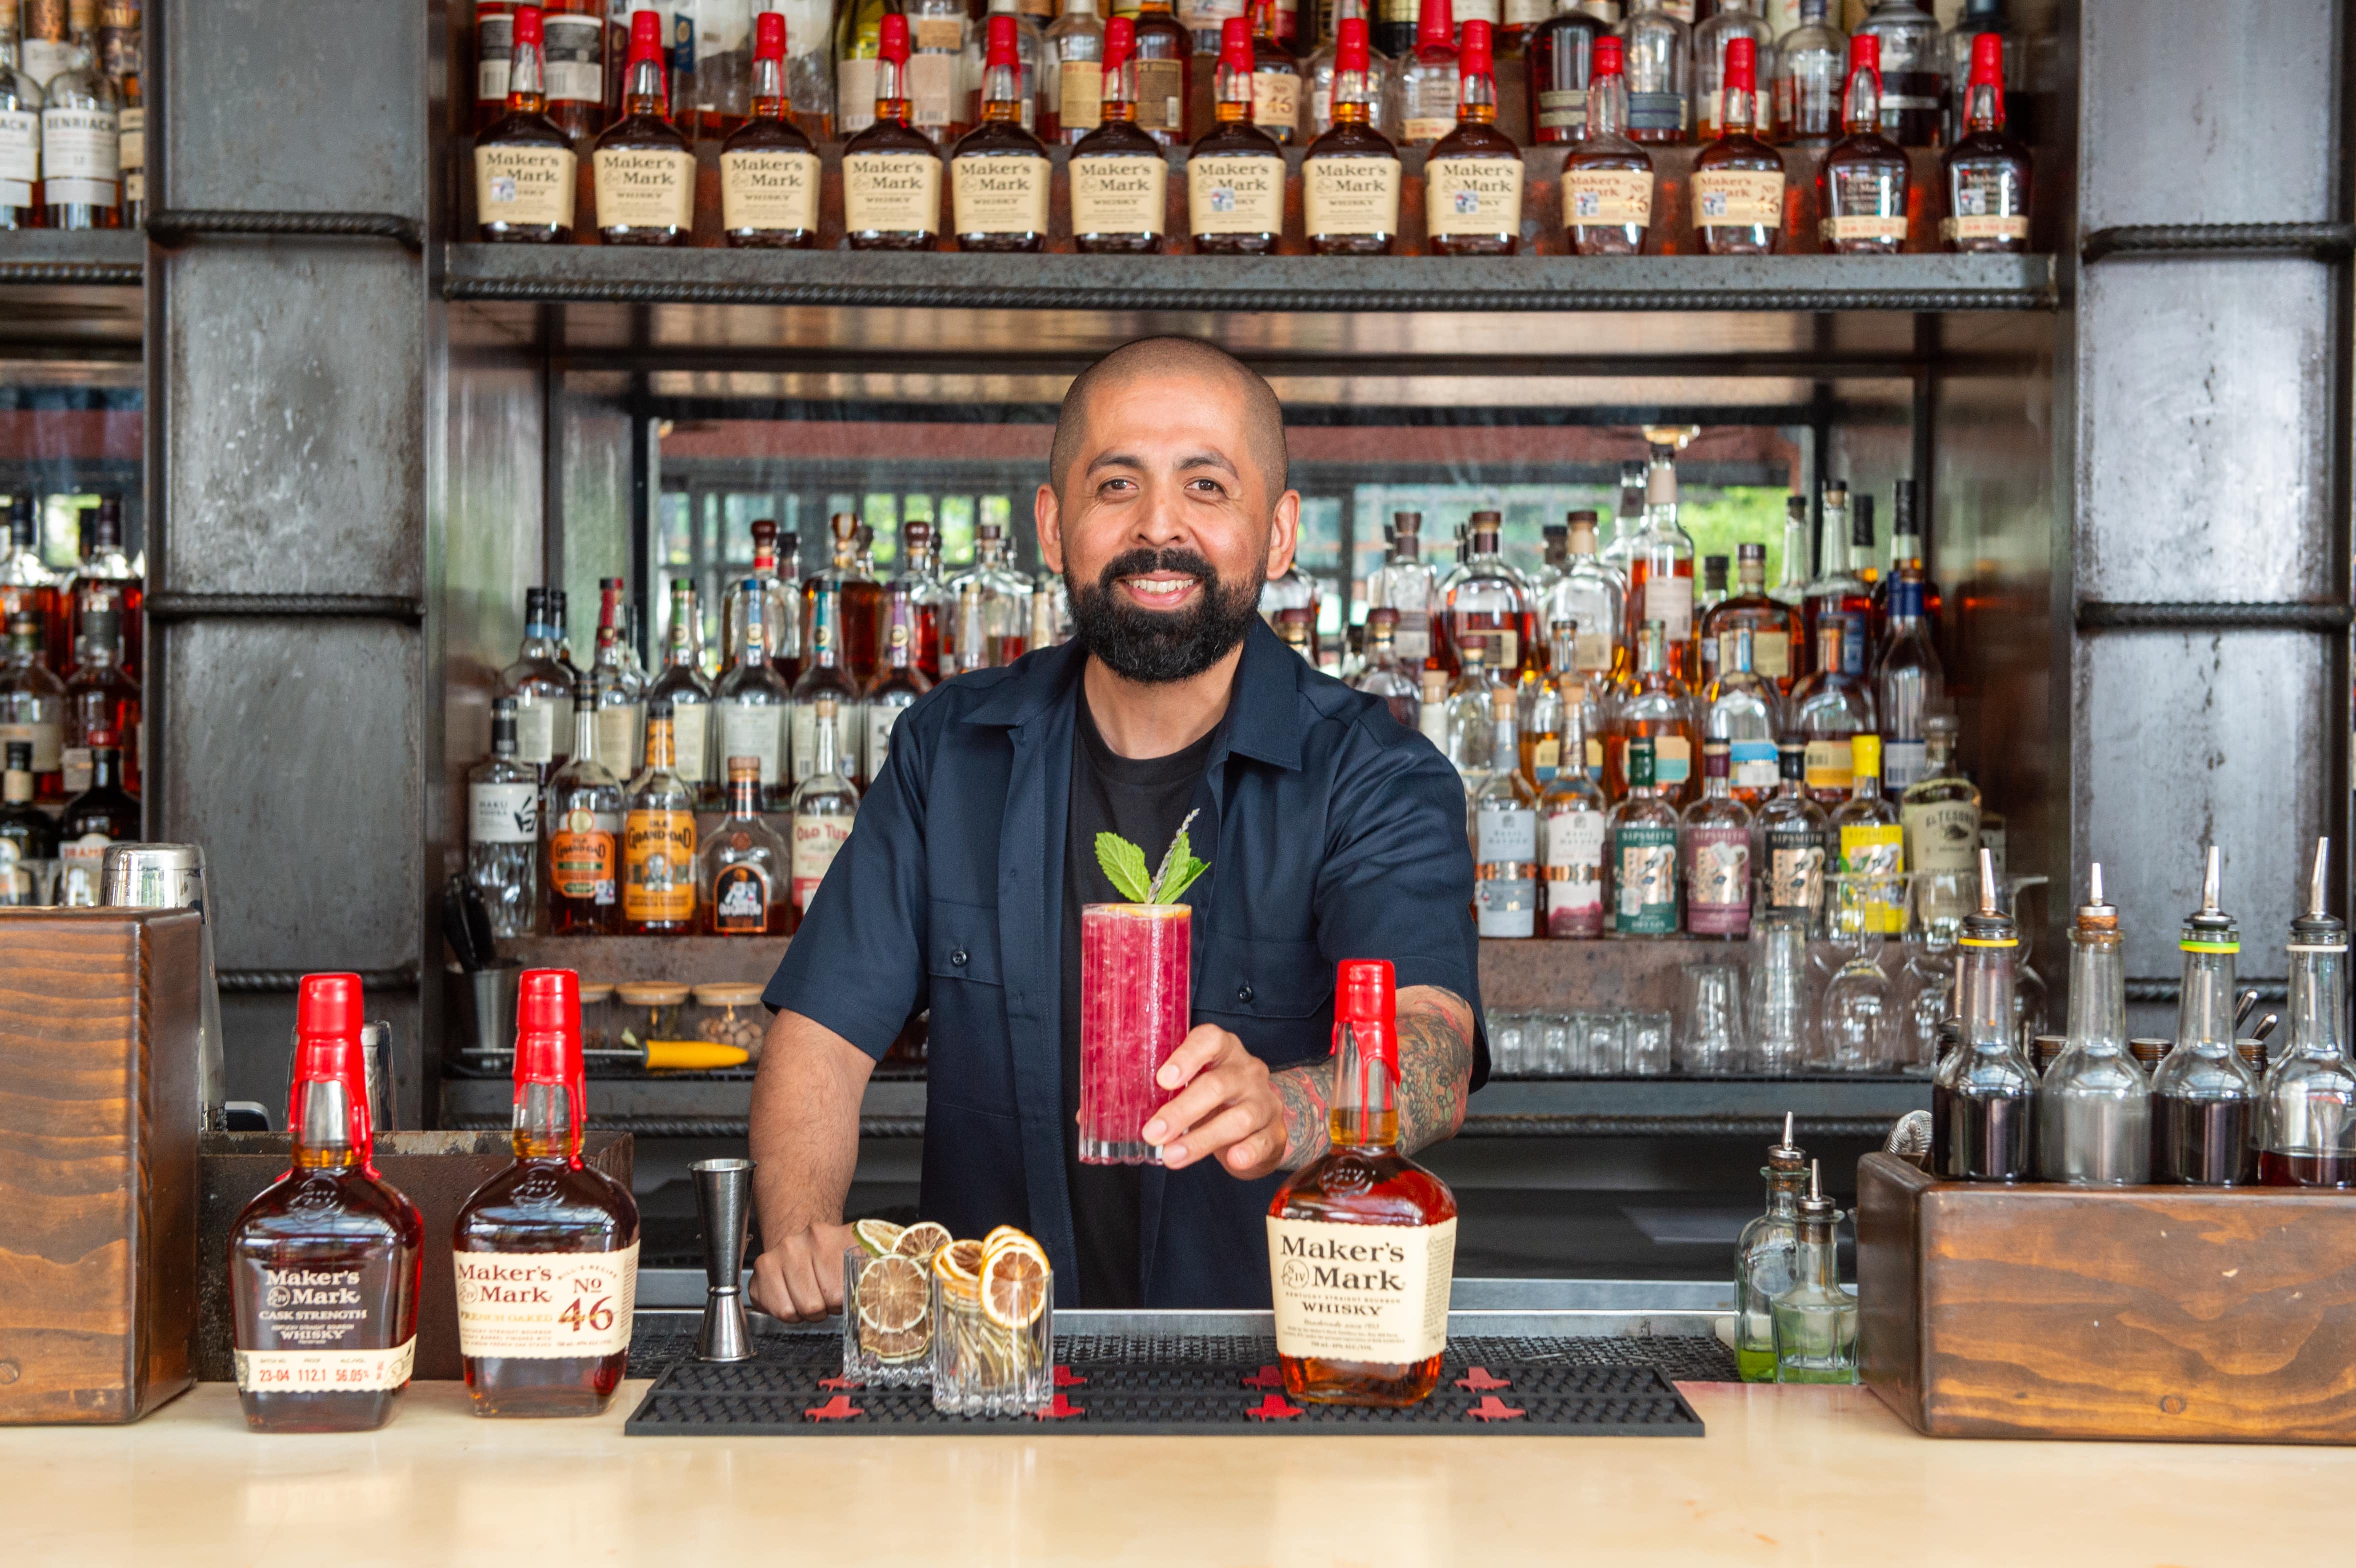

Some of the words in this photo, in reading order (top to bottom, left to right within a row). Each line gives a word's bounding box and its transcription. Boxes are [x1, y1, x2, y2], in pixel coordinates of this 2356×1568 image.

[486, 152, 559, 167] Maker's
[604, 155, 675, 169] Maker's
[732, 158, 803, 172] Maker's
[852, 161, 924, 174] Maker's
[960, 163, 1031, 175] Maker's
[1080, 163, 1151, 176] Maker's
[1198, 164, 1269, 175] Maker's
[1316, 164, 1387, 176] Maker's
[1443, 164, 1514, 176] Maker's
[624, 172, 675, 185] Mark
[751, 175, 803, 187] Mark
[872, 177, 924, 189] Mark
[980, 179, 1031, 190] Mark
[1100, 179, 1151, 191] Mark
[1335, 179, 1385, 191] Mark
[1570, 176, 1621, 186] Maker's
[1701, 176, 1751, 186] Maker's
[1623, 194, 1649, 213] 46
[1754, 195, 1780, 213] 46
[1622, 831, 1673, 841] SIPSMITH
[1280, 1234, 1404, 1263] Maker's
[265, 1269, 360, 1286] Maker's
[458, 1263, 552, 1281] Maker's
[1311, 1266, 1405, 1291] Mark
[291, 1287, 361, 1305] Mark
[479, 1285, 553, 1303] Mark
[258, 1310, 295, 1320] CASK
[295, 1309, 368, 1320] STRENGTH
[558, 1295, 613, 1332] 46
[1302, 1301, 1381, 1316] WHISKY
[280, 1329, 346, 1340] WHISKY
[259, 1369, 290, 1382] 23-04
[298, 1368, 326, 1382] 112.1
[336, 1369, 370, 1382] 56.05%
